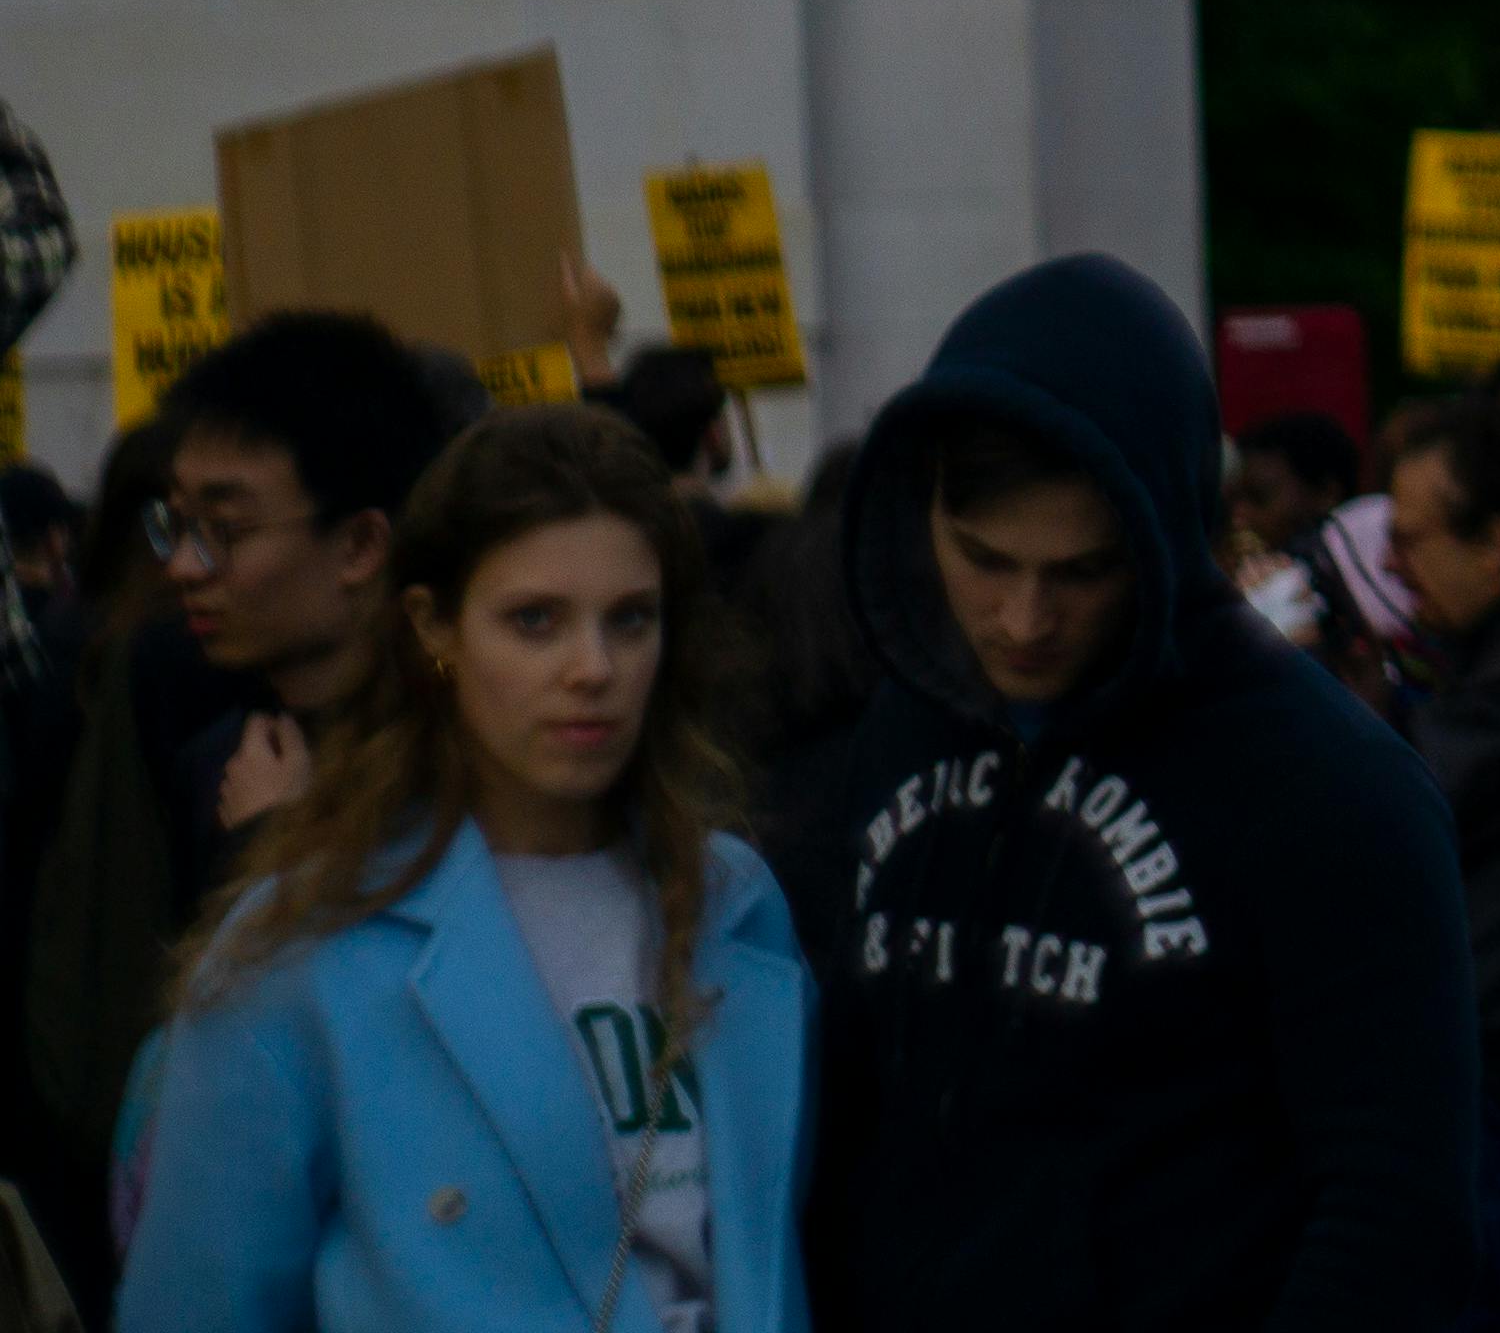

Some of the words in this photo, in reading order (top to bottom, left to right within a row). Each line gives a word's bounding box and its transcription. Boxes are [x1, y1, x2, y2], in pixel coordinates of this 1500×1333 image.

[160, 278, 197, 320] IS
[855, 747, 1210, 961] BERCROMBIE
[861, 910, 890, 976] &
